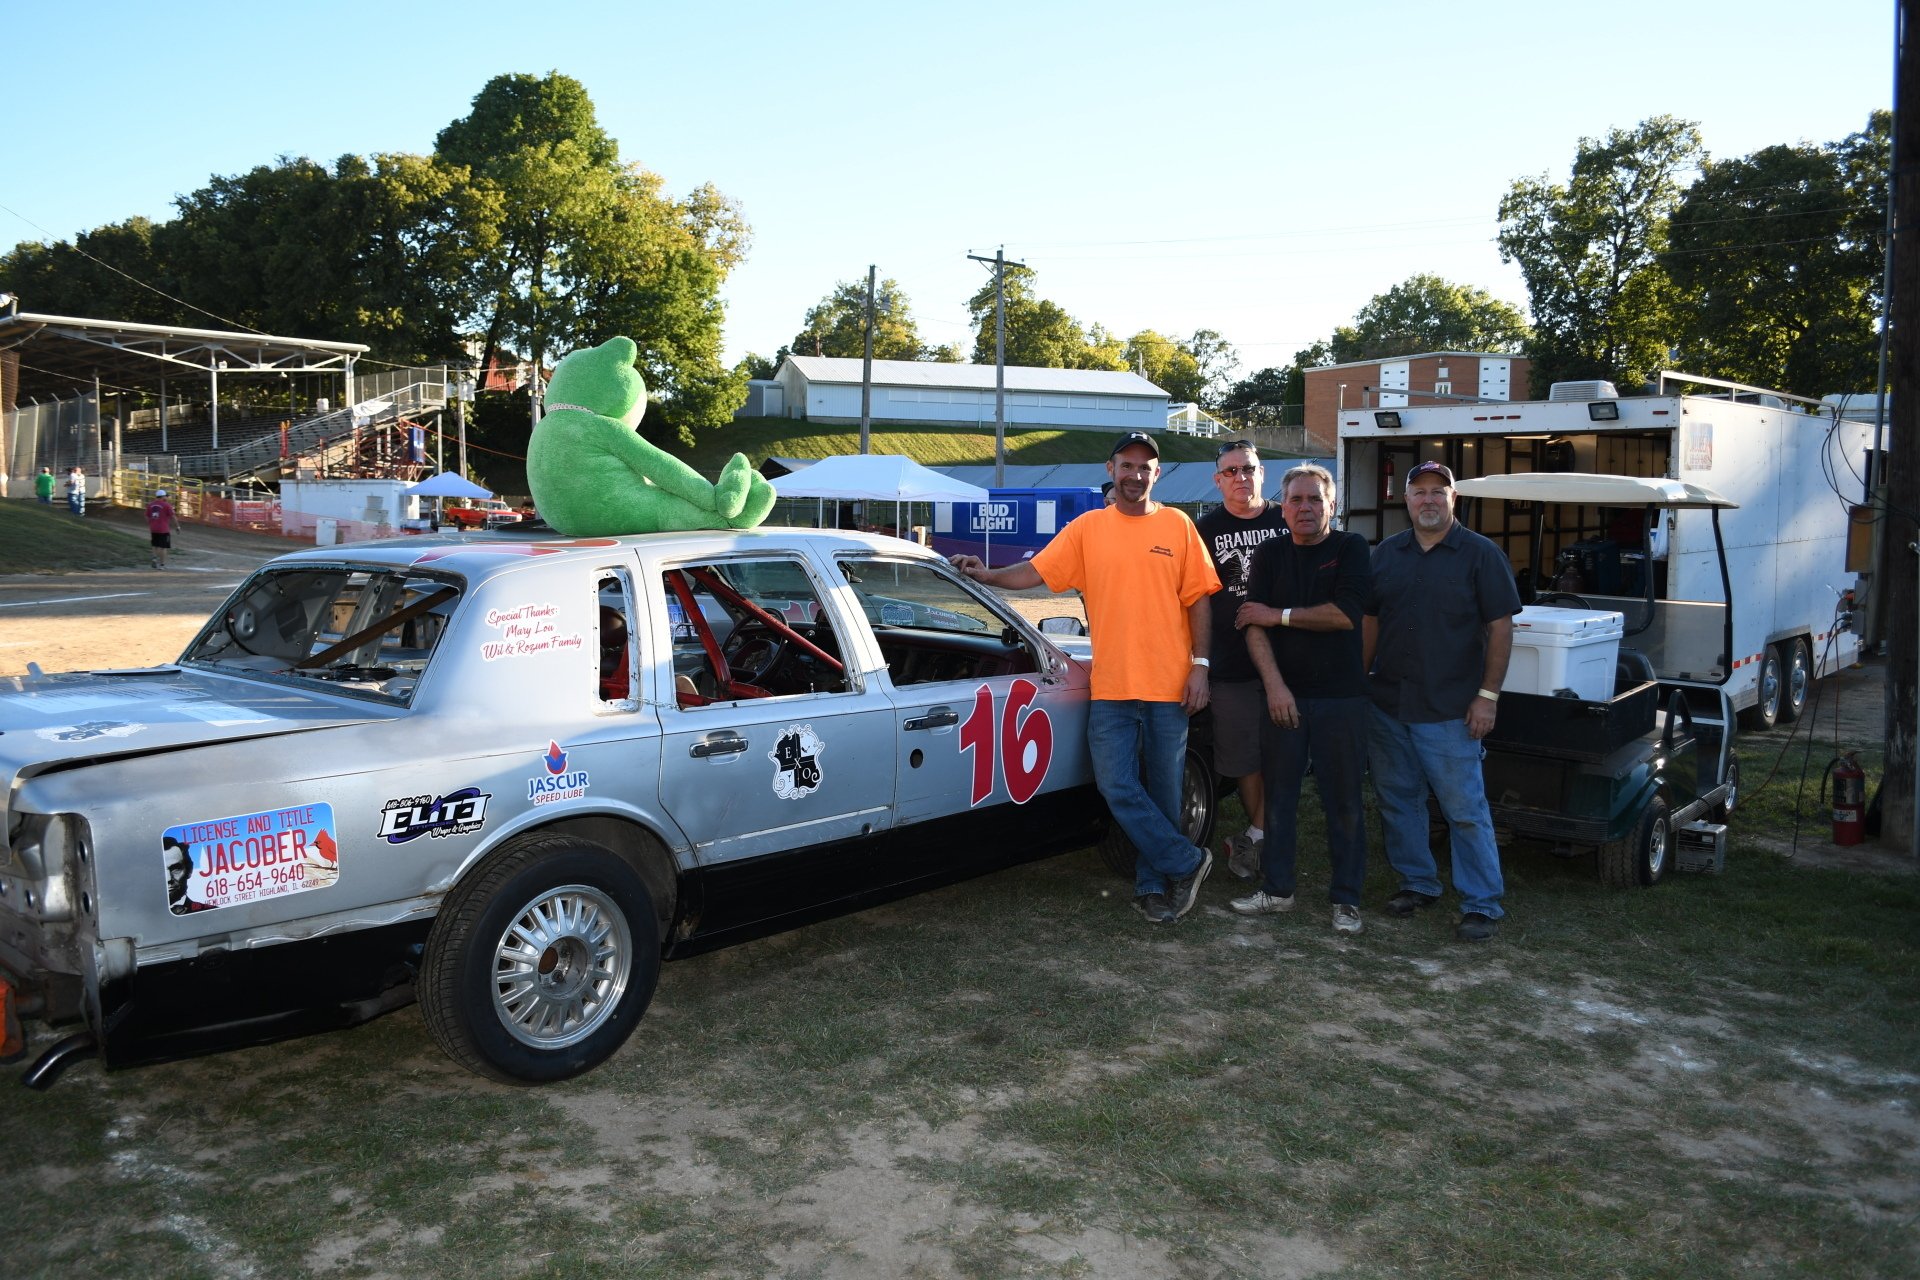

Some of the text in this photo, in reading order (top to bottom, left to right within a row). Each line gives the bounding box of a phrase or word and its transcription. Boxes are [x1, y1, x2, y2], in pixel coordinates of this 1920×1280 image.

[978, 504, 1009, 517] BUD
[973, 517, 1015, 530] LIGHT
[487, 605, 558, 626] Special Thanks:
[506, 621, 555, 639] Mary Lou
[483, 634, 582, 659] Wil & Rozum Family
[959, 678, 1053, 807] 16
[528, 772, 588, 798] JASCUR
[535, 788, 584, 804] SPEED LUBE
[182, 808, 315, 845] LICENSE AND TITLE
[199, 829, 308, 878] JACOBER
[206, 863, 305, 898] 618-654-9640
[234, 890, 256, 902] STREET
[259, 884, 290, 898] HIGHLAND,
[292, 882, 299, 891] IL
